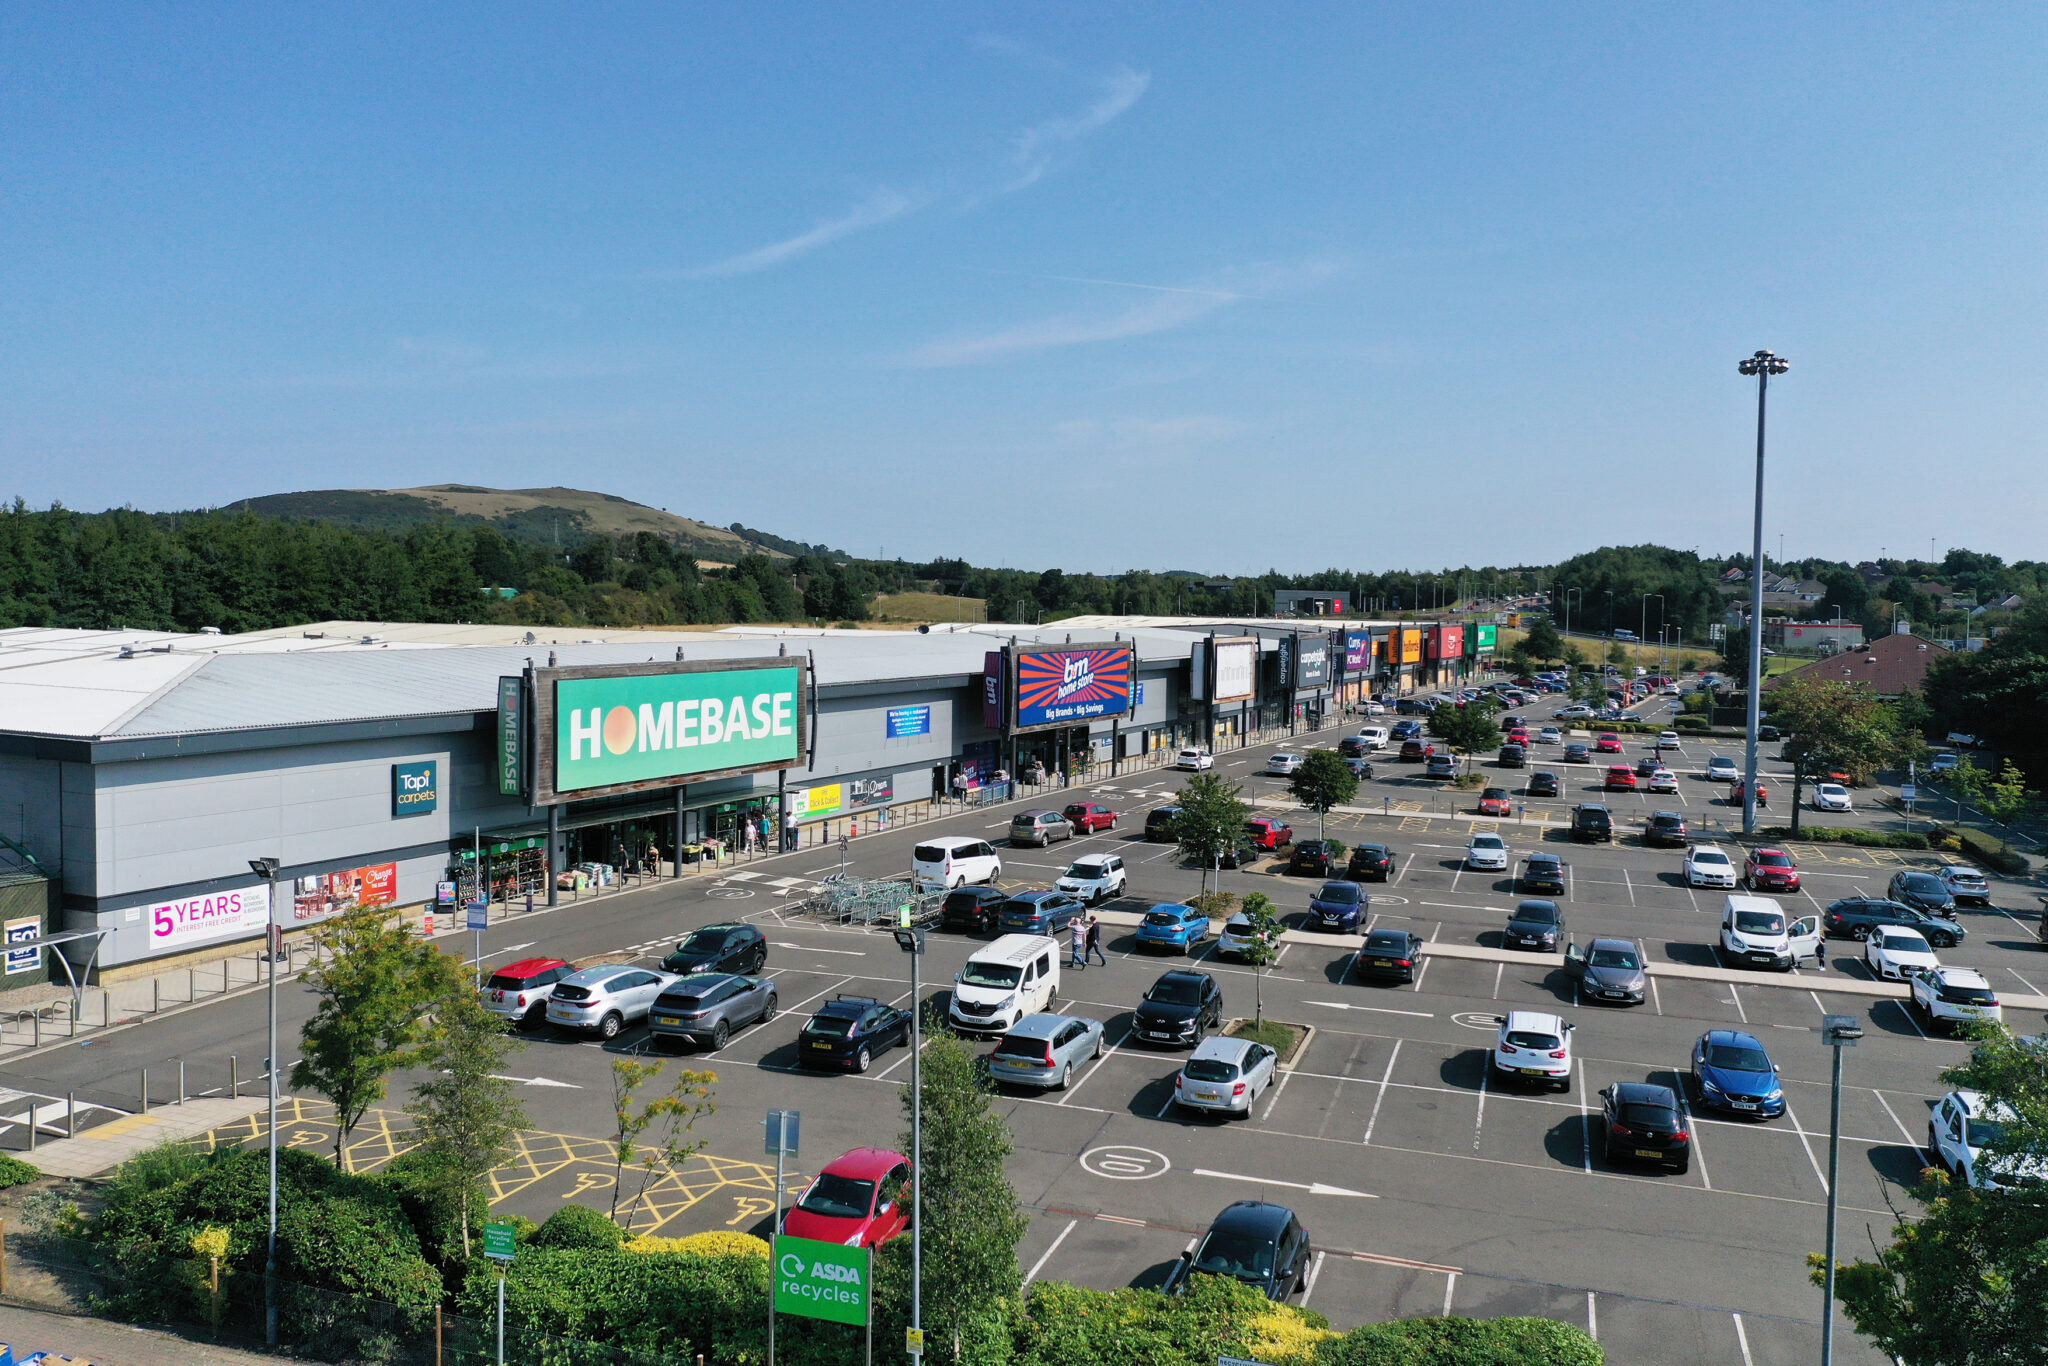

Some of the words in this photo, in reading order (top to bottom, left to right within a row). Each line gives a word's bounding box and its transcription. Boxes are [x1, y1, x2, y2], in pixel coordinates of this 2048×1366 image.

[1058, 680, 1077, 699] home
[1077, 672, 1094, 690] store
[1046, 708, 1055, 720] Big
[1055, 706, 1073, 717] Brands
[1076, 704, 1085, 716] Big
[1085, 702, 1104, 714] Savings
[505, 683, 517, 790] HOMEBASE
[570, 692, 792, 761] HOMEBASE
[400, 770, 429, 791] Tapi
[398, 790, 435, 804] carpets
[366, 868, 392, 883] Change
[154, 906, 173, 937] 5
[175, 893, 241, 923] YEARS
[176, 918, 204, 934] INTEREST
[204, 919, 219, 929] FREE
[220, 914, 241, 925] CREDIT
[811, 1262, 860, 1285] ASDA
[782, 1281, 859, 1305] recycles
